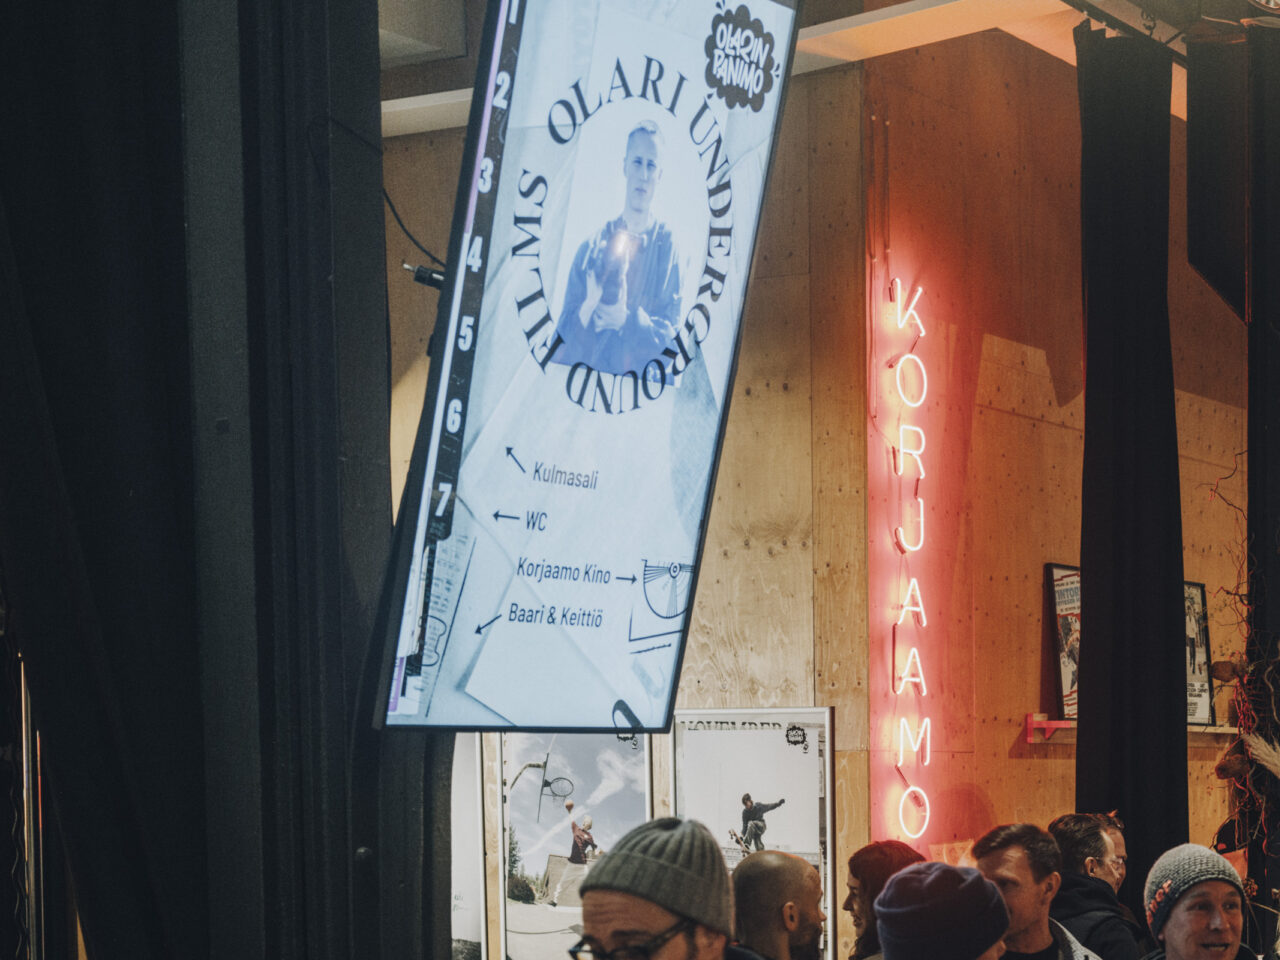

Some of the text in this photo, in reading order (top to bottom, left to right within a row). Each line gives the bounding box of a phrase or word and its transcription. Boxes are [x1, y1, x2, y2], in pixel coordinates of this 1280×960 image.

[715, 22, 770, 68] OLARIN
[492, 71, 511, 110] 2
[712, 48, 764, 98] PANIMO
[478, 157, 494, 194] 3
[511, 54, 734, 414] OLARI UNDERGROUND FILMS
[467, 236, 483, 272] 4
[458, 315, 474, 351] 5
[446, 399, 462, 434] 6
[532, 461, 599, 490] Kulmasali
[435, 483, 452, 517] 7
[526, 510, 548, 532] WC
[516, 556, 611, 585] Korjaamo Kino
[895, 278, 930, 839] KORJAAMO
[508, 602, 604, 628] Baari & Keittiö
